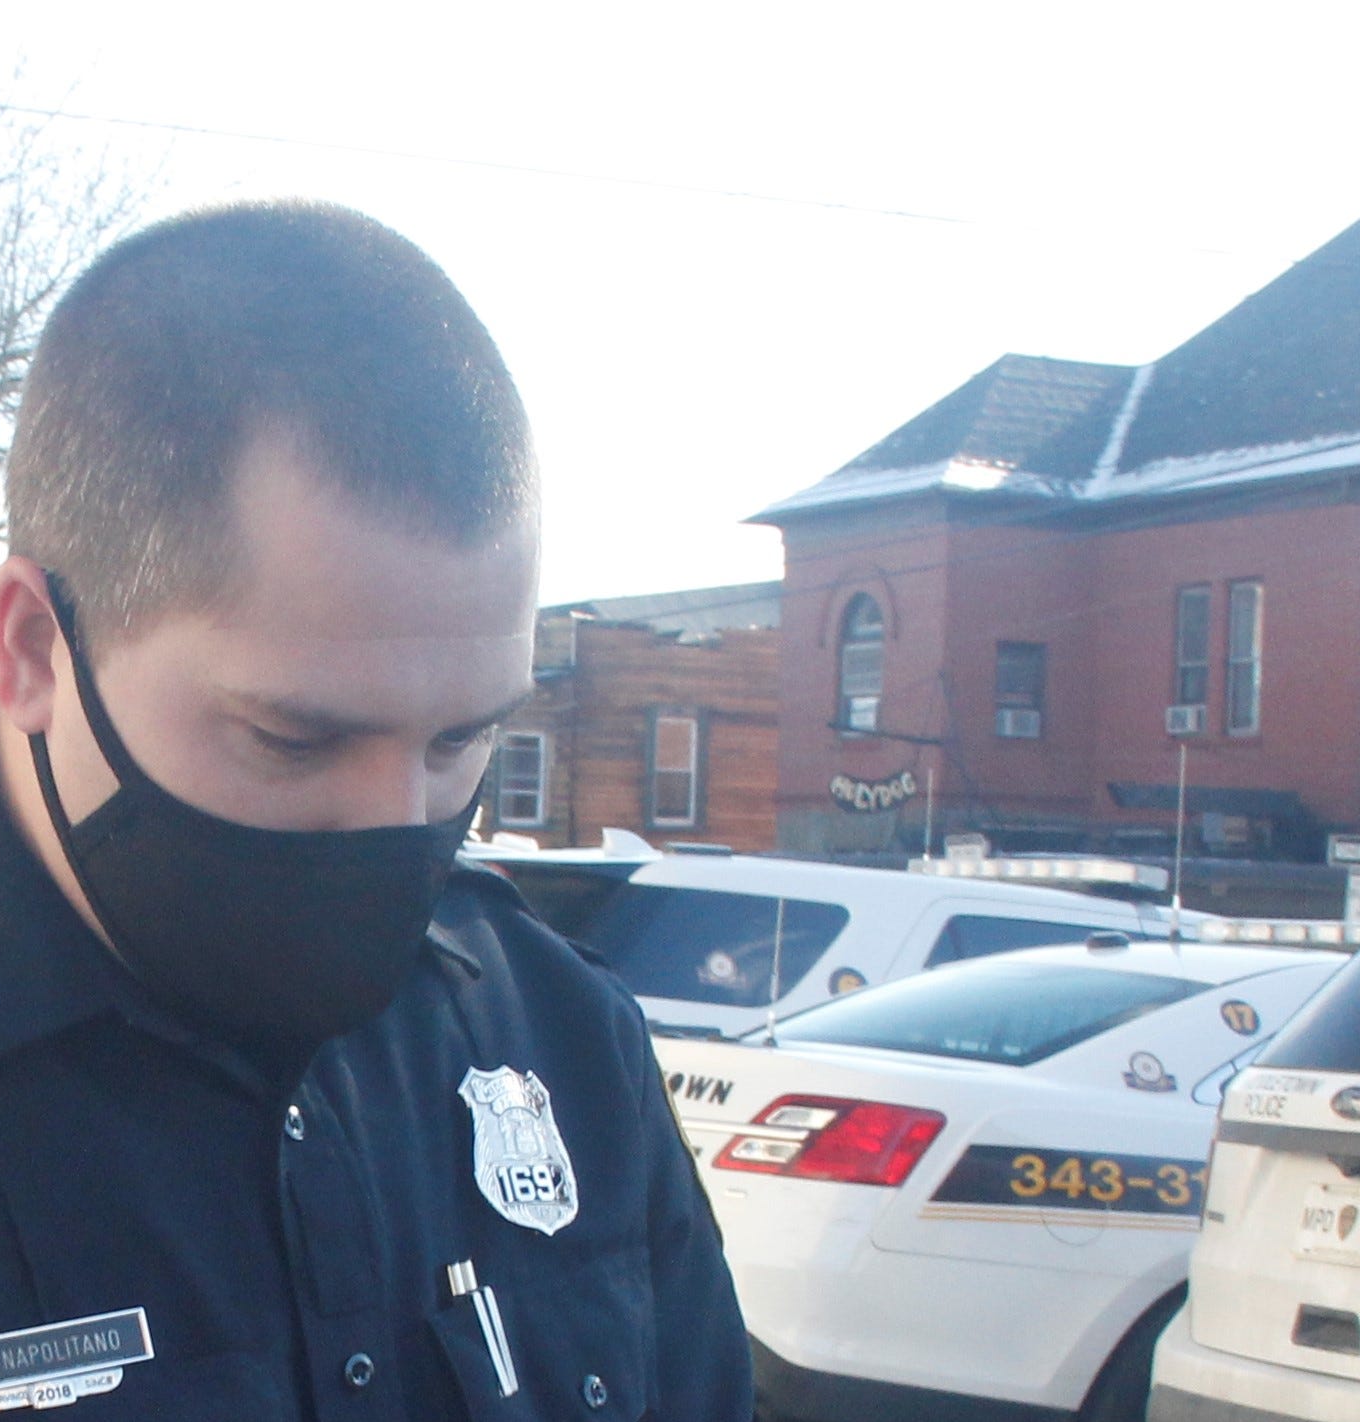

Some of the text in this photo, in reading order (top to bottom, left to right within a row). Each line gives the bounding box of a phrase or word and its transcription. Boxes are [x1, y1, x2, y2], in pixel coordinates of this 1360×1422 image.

[1223, 1004, 1255, 1031] 17
[662, 1070, 735, 1106] OWN
[497, 1166, 556, 1202] 169
[1, 1329, 121, 1370] NAPOLITANO
[36, 1384, 71, 1402] 2018
